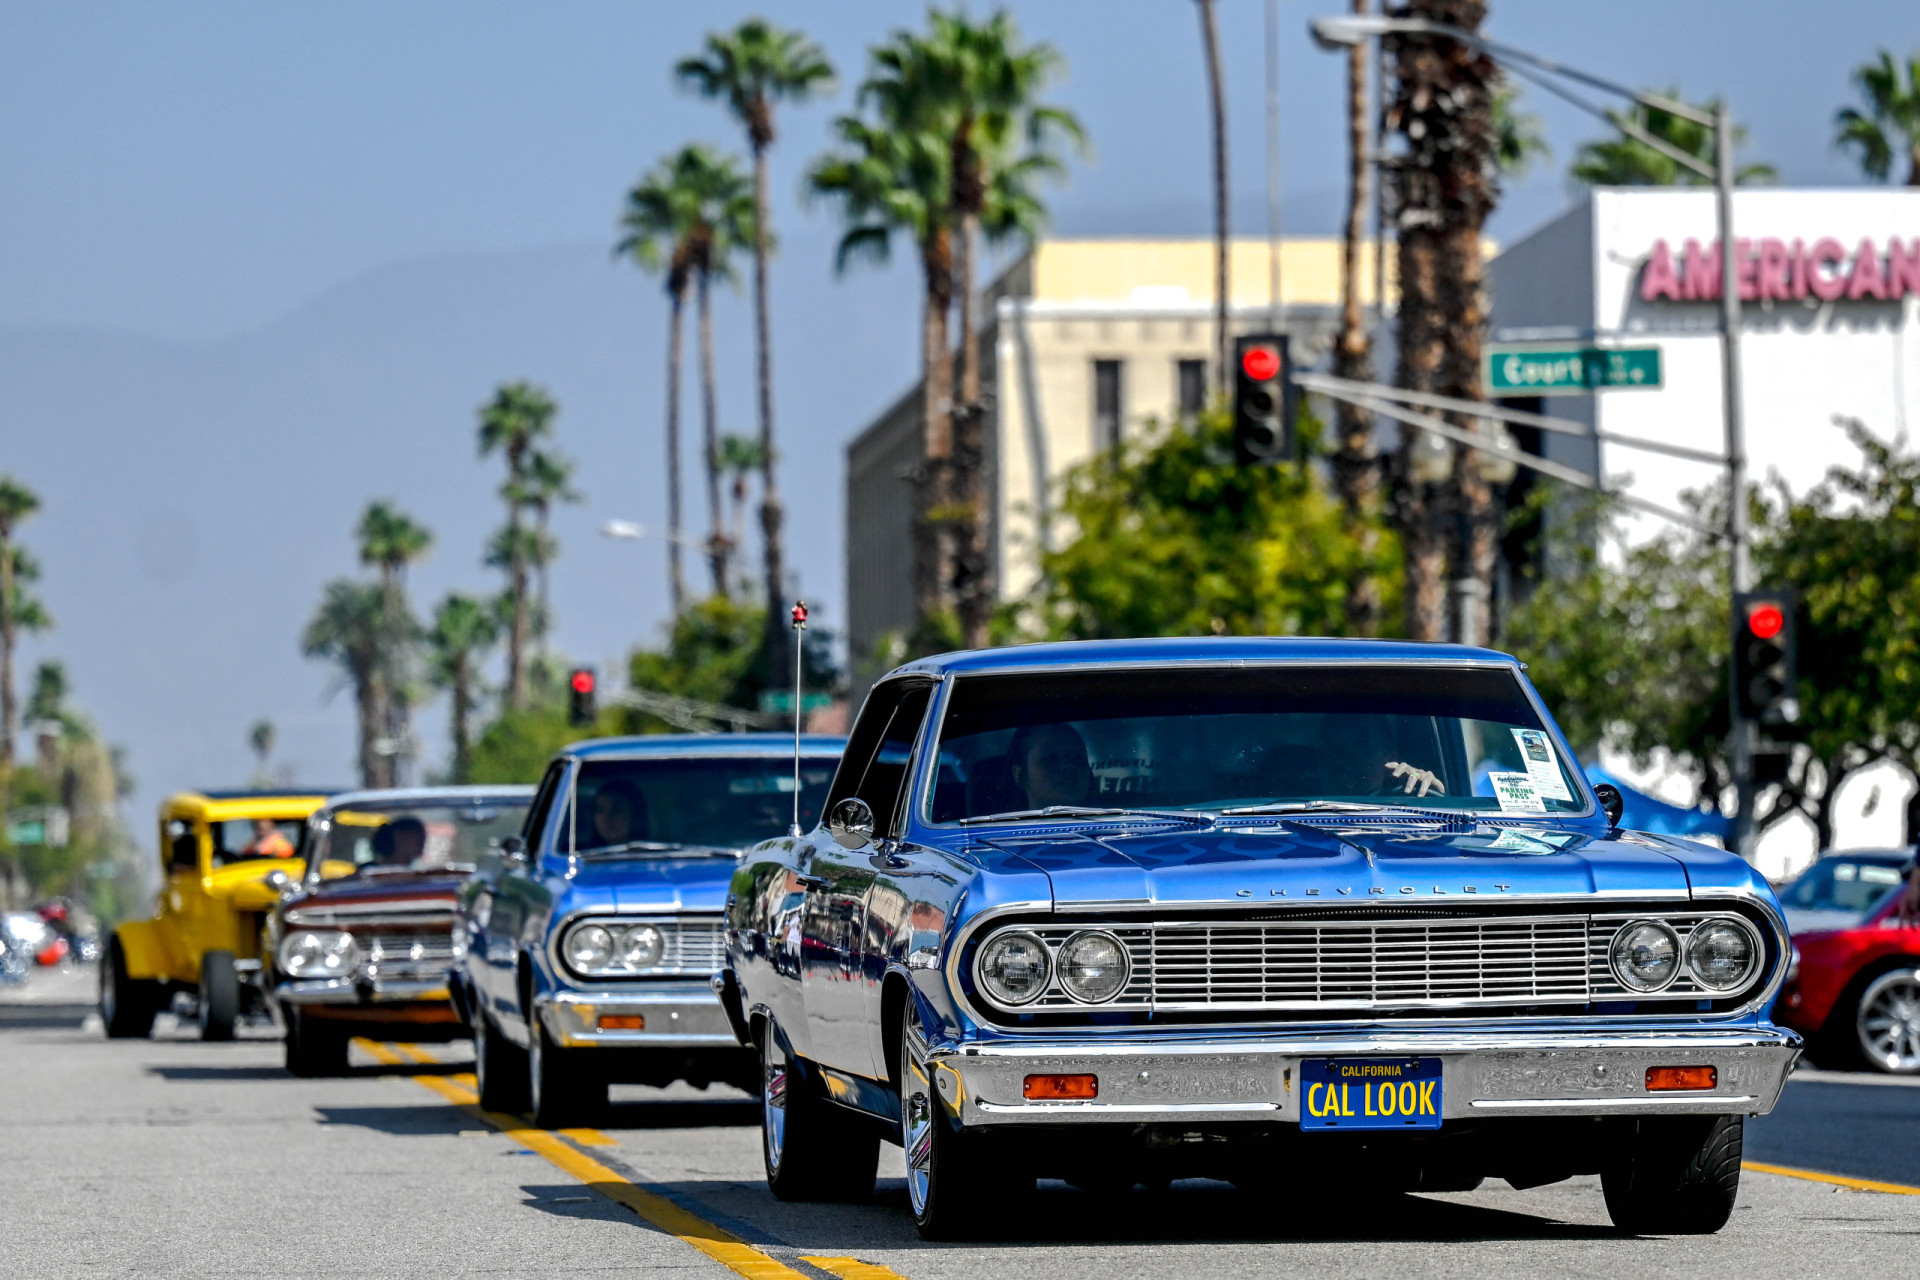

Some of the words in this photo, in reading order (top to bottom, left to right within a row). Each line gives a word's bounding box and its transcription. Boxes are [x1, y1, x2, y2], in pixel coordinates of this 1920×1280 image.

[1641, 236, 1920, 302] AMERICAN
[1503, 355, 1583, 385] Court
[1500, 787, 1535, 795] PARKING
[1509, 792, 1530, 800] PASS
[1236, 884, 1511, 897] CHEVROLET
[1341, 1065, 1402, 1077] CALIFORNIA
[1307, 1082, 1355, 1117] CAL
[1364, 1080, 1436, 1116] LOOK
